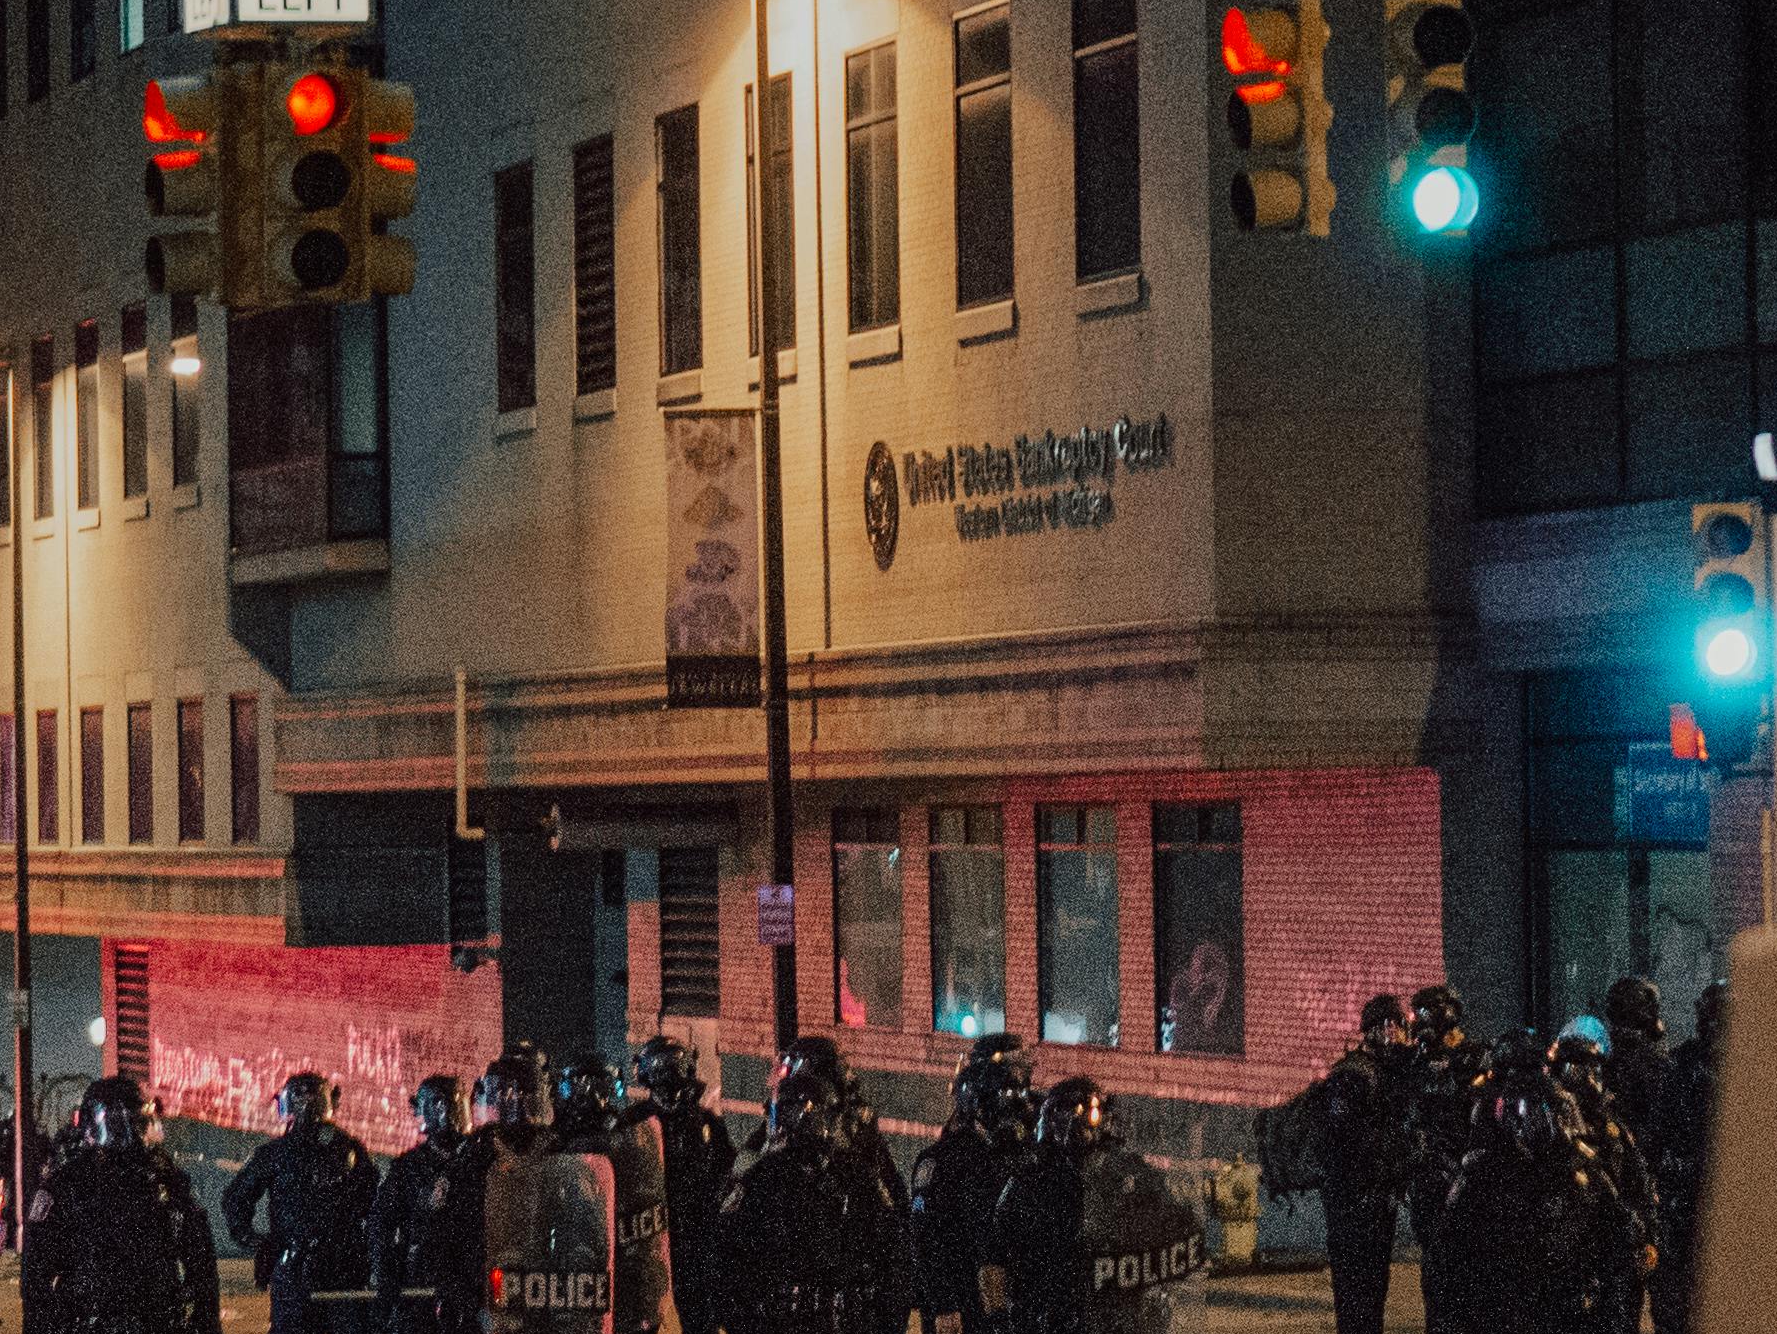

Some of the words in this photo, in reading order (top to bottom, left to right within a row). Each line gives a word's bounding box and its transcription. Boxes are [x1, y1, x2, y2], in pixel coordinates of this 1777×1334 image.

[618, 1203, 663, 1244] LICE
[1094, 1233, 1200, 1290] POLICE
[503, 1272, 608, 1308] POLICE
